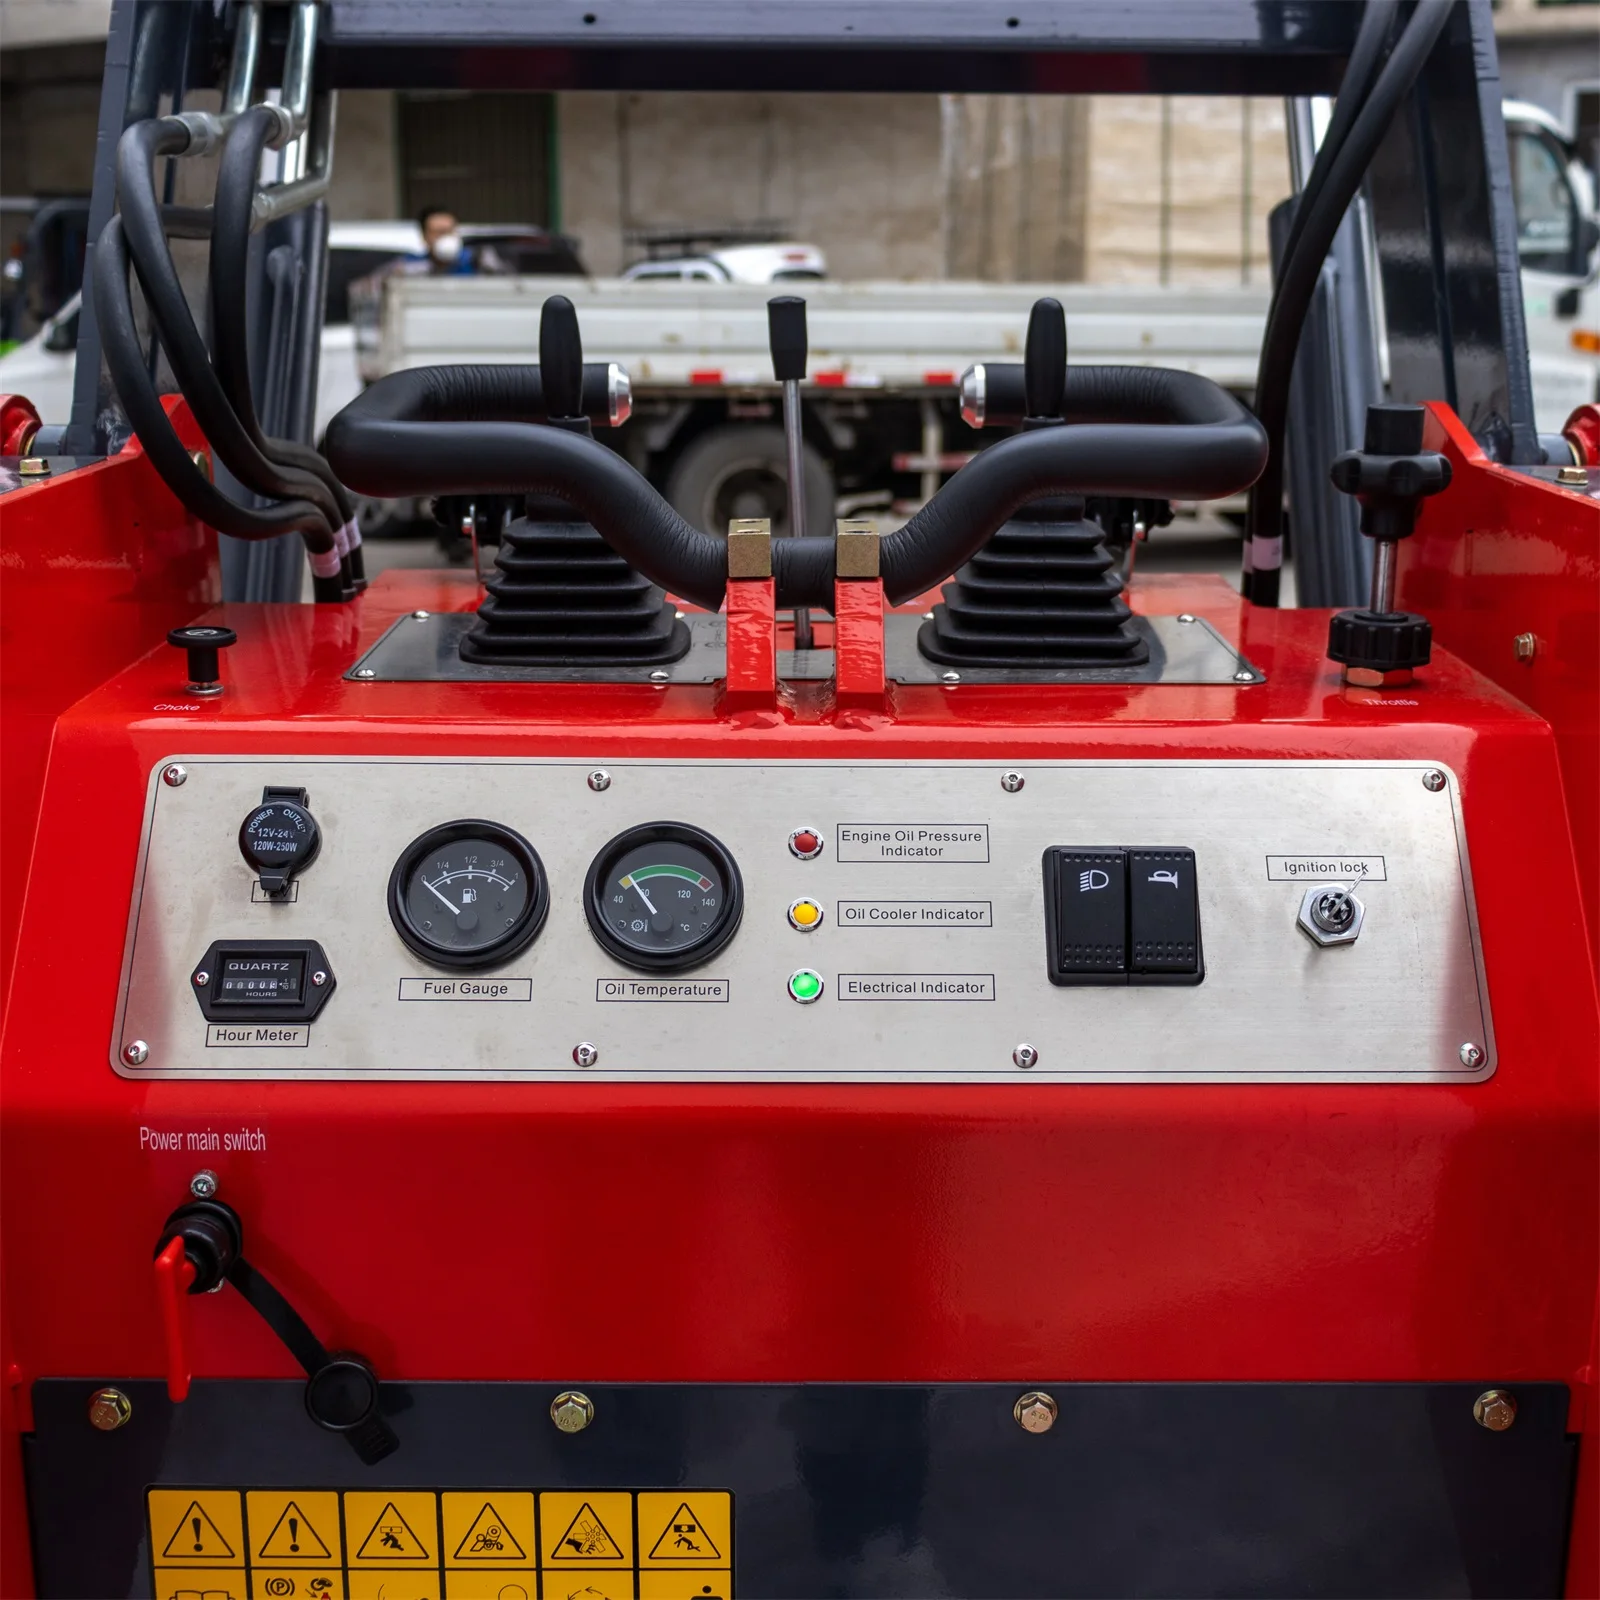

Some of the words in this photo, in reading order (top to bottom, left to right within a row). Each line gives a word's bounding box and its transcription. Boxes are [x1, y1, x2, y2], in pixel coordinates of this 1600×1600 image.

[1362, 698, 1419, 706] Throttle
[248, 808, 274, 833] POWER
[841, 830, 891, 844] Engine
[894, 830, 915, 842] Oil
[918, 830, 982, 842] Pressure
[253, 841, 298, 852] 120W-250W
[881, 845, 944, 857] Indicator
[436, 861, 449, 869] 1/4
[464, 856, 478, 864] 1/2
[490, 860, 504, 868] 3/4
[1284, 862, 1336, 875] Ignition
[1340, 862, 1369, 873] lock
[613, 895, 624, 904] 40
[677, 889, 691, 899] 120
[702, 898, 715, 907] 140
[845, 908, 865, 920] Oil
[869, 908, 917, 920] Cooler
[921, 908, 985, 920] Indicator
[228, 962, 290, 971] QUARTZ
[424, 982, 455, 995] Fuel
[460, 982, 508, 997] Gauge
[605, 983, 627, 996] Oil
[629, 984, 722, 998] Temperature
[848, 981, 917, 994] Electrical
[921, 981, 985, 994] Indicator
[216, 1029, 252, 1041] Hour
[255, 1029, 298, 1041] Meter
[140, 1126, 183, 1150] Power
[187, 1127, 220, 1150] main
[224, 1127, 266, 1151] switch
